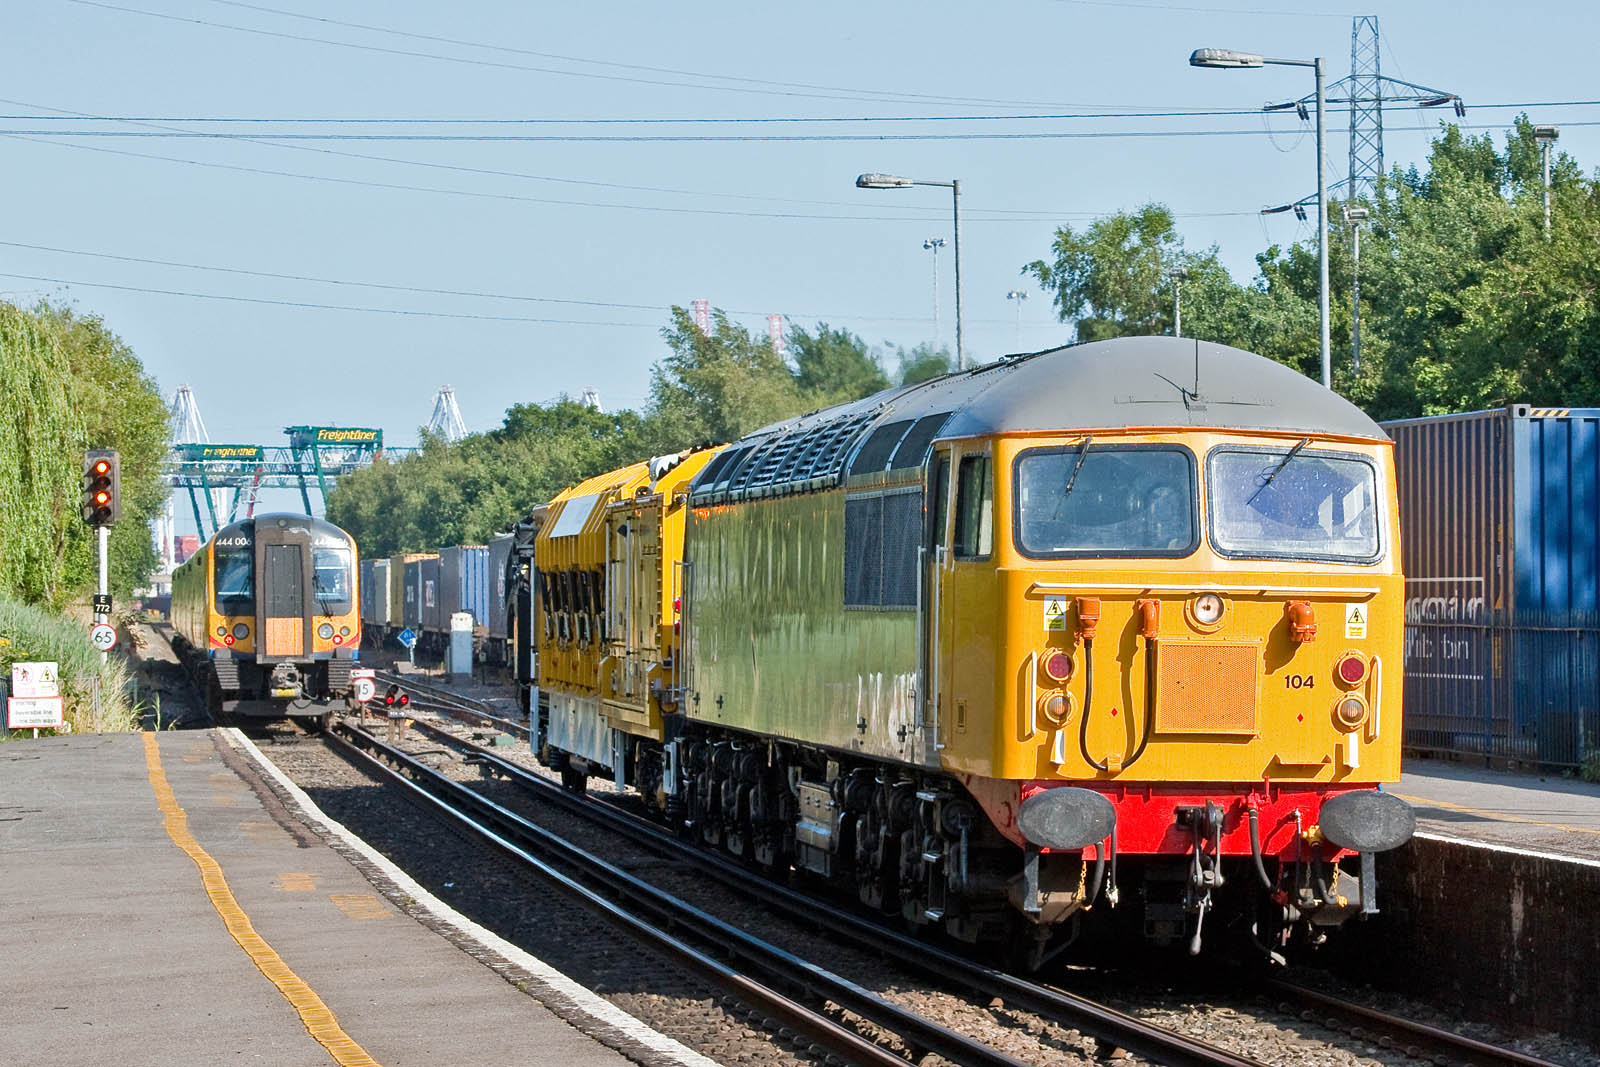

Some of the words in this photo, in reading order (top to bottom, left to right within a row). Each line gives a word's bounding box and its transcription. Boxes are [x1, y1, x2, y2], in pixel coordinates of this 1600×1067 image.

[317, 429, 377, 442] Freightliner
[215, 538, 233, 546] 444
[100, 596, 106, 604] E
[95, 604, 110, 612] 772
[95, 631, 112, 643] 65
[1284, 674, 1315, 689] 104
